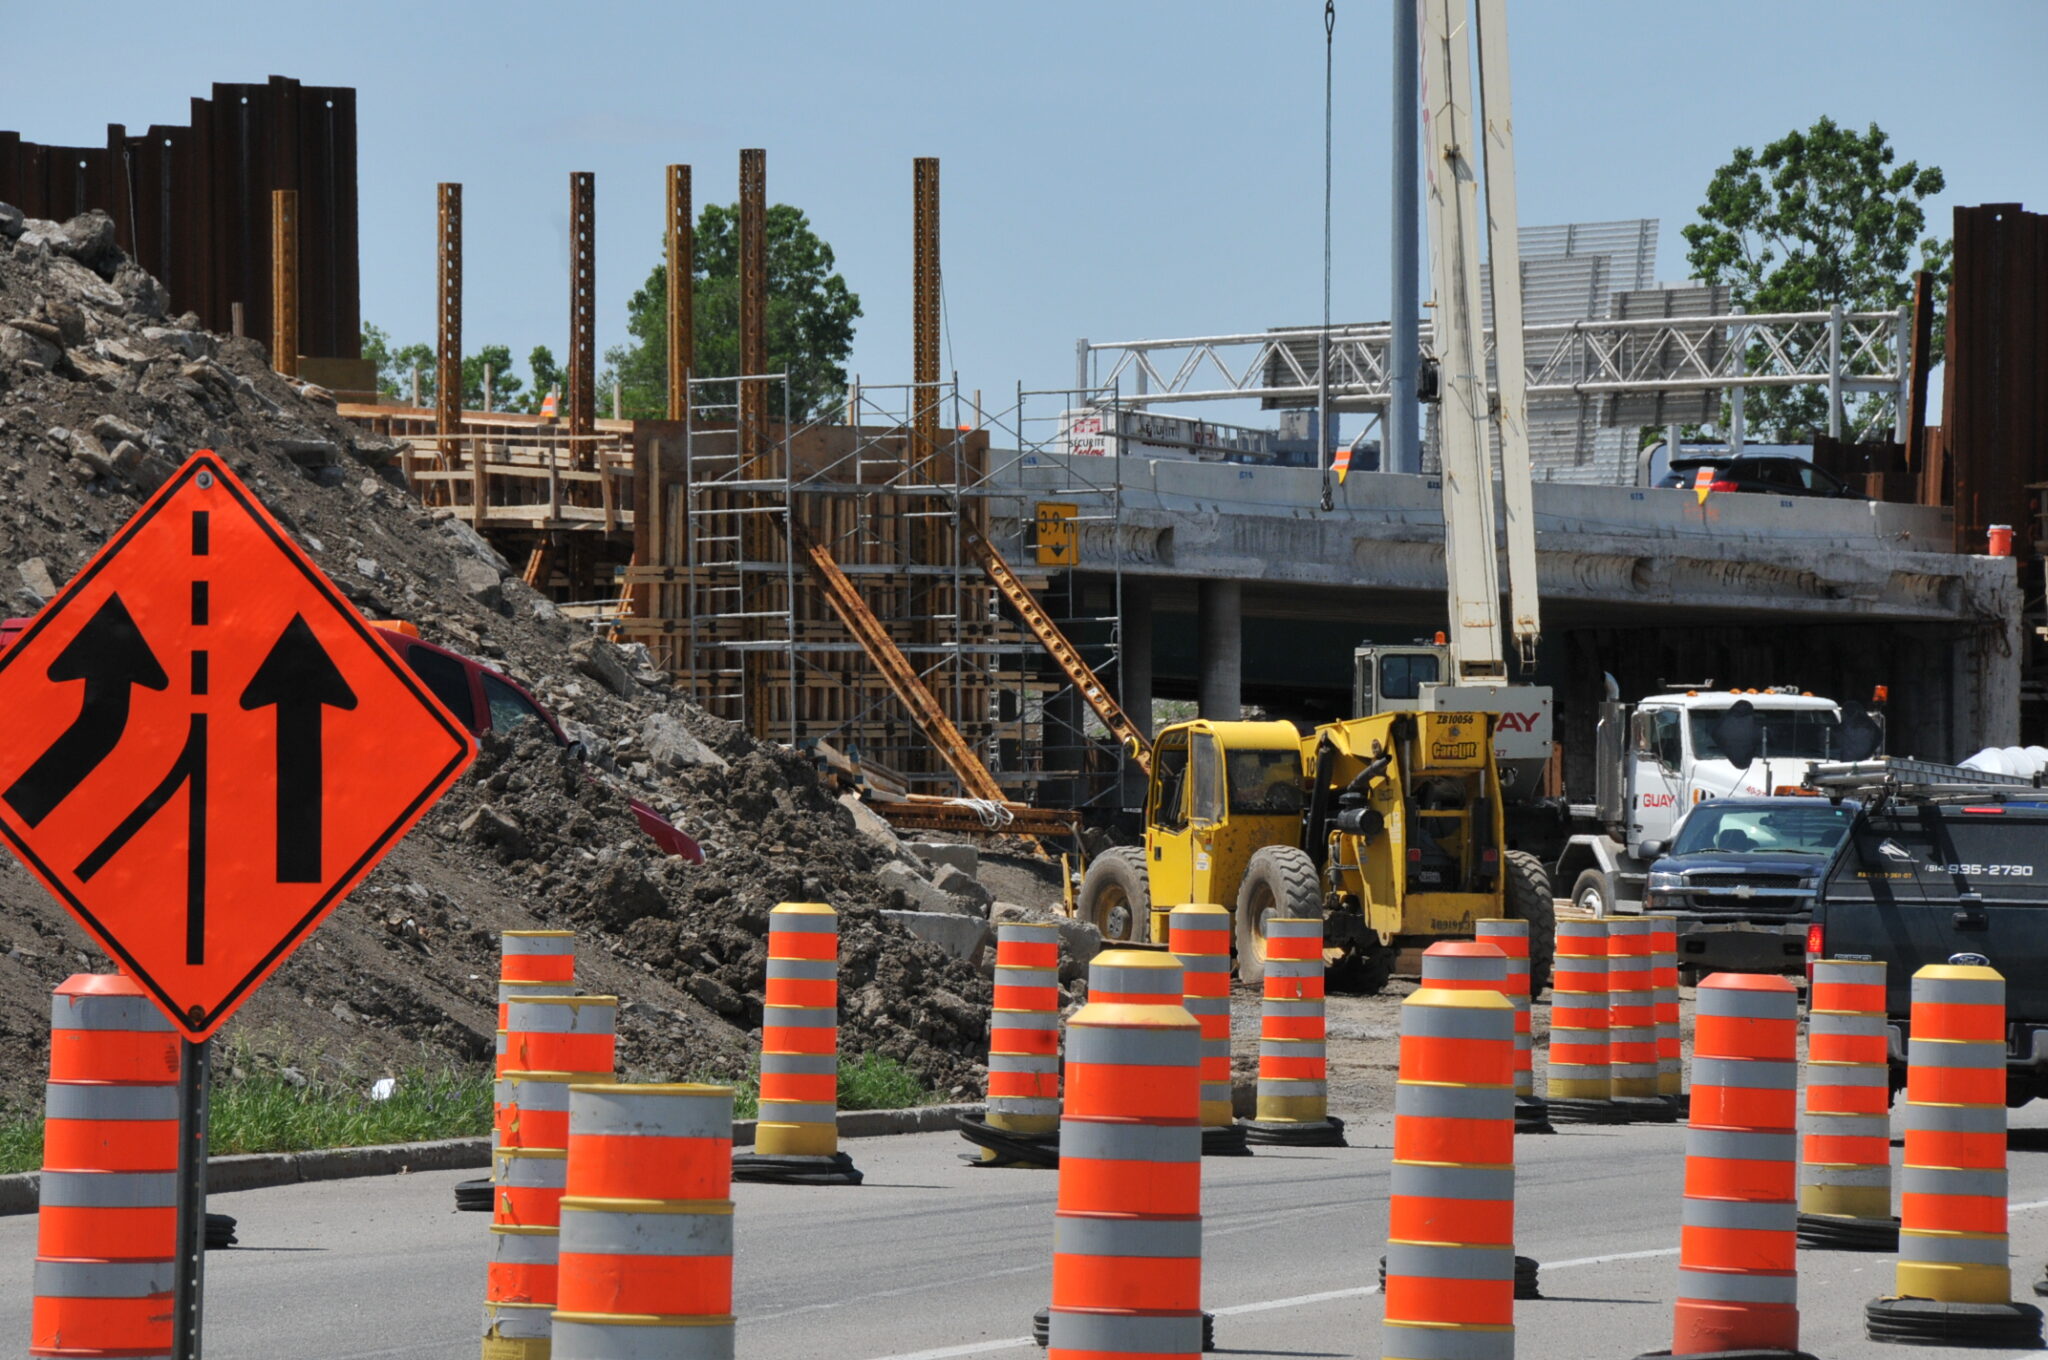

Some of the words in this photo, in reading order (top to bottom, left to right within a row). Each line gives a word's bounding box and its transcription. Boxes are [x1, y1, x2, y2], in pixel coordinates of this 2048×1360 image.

[1496, 712, 1540, 732] AY
[1643, 793, 1675, 807] GUAY
[1948, 863, 2033, 876] 935-2730
